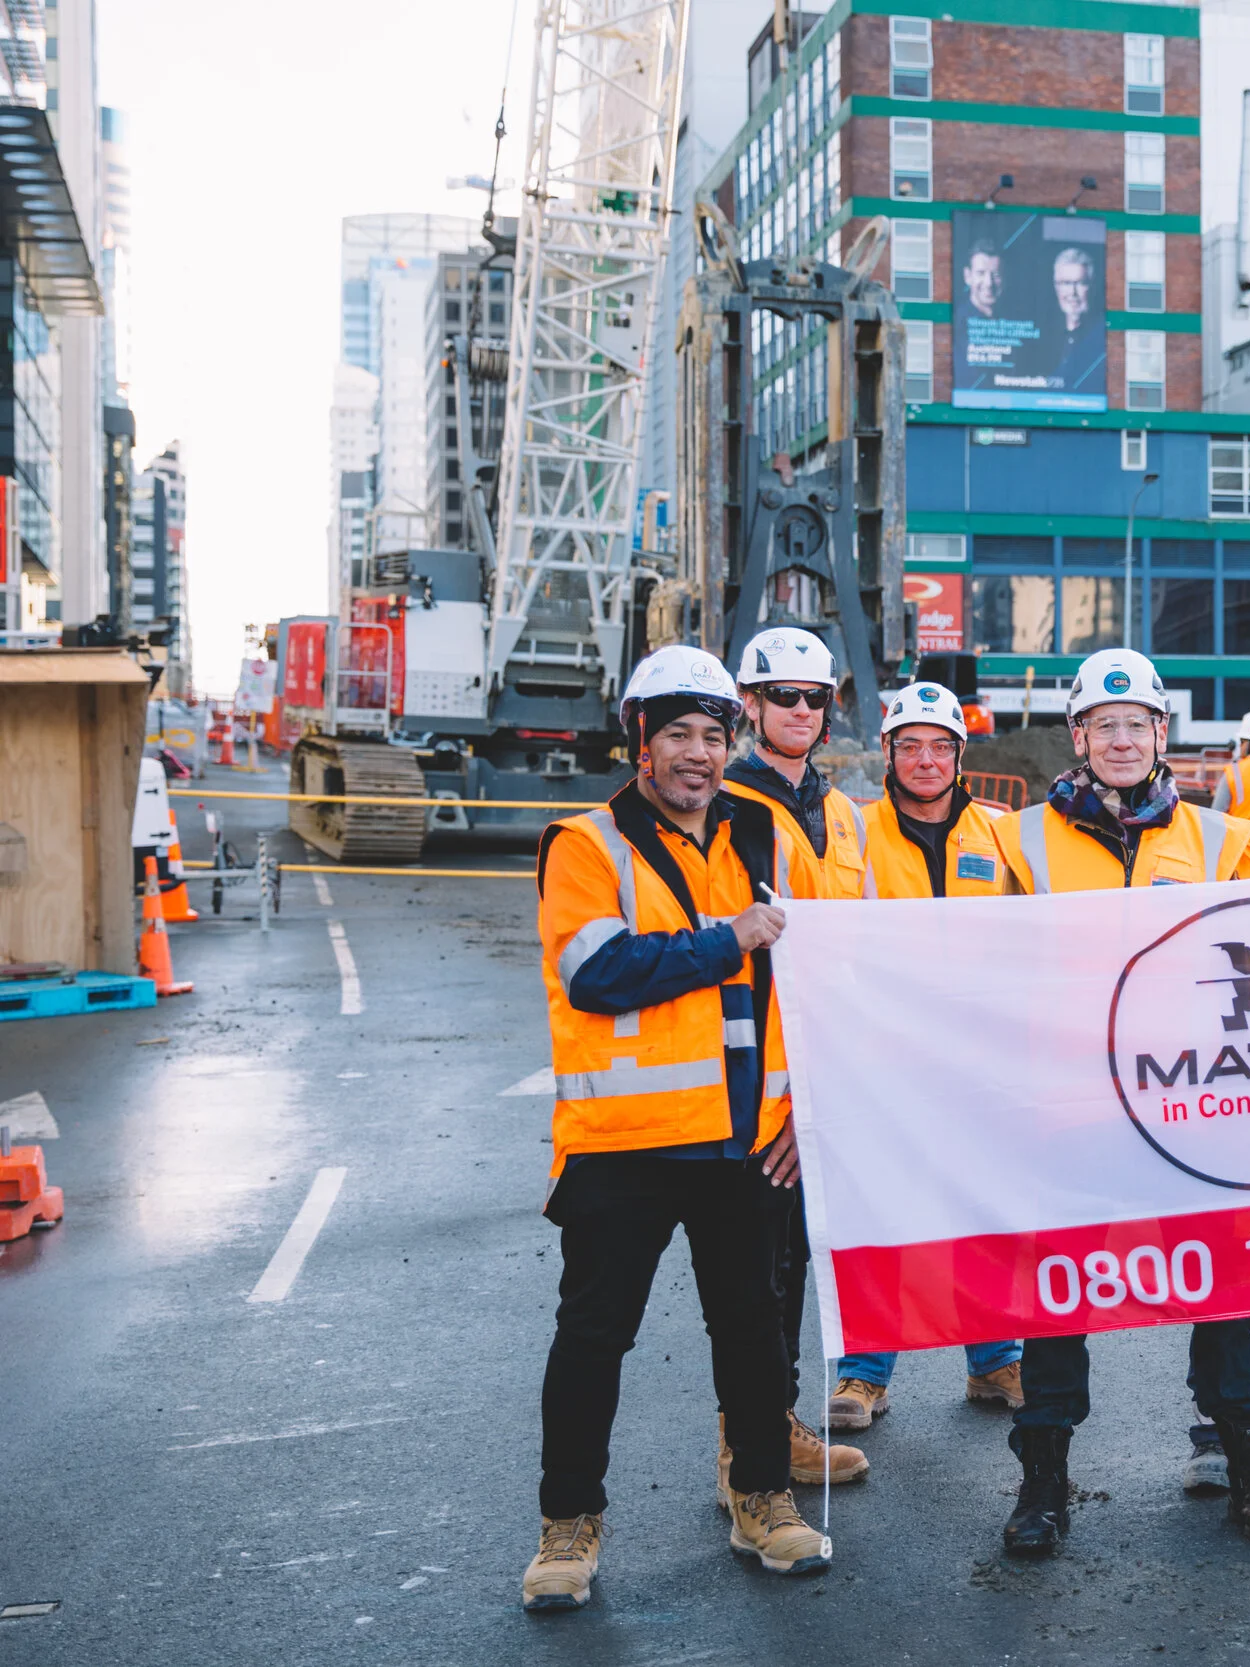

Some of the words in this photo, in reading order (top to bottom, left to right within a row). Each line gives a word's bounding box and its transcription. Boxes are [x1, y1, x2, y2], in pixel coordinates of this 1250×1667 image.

[918, 610, 954, 630] odge
[918, 637, 962, 651] NTRAL
[1161, 1097, 1189, 1123] in
[1036, 1239, 1214, 1316] 0800
